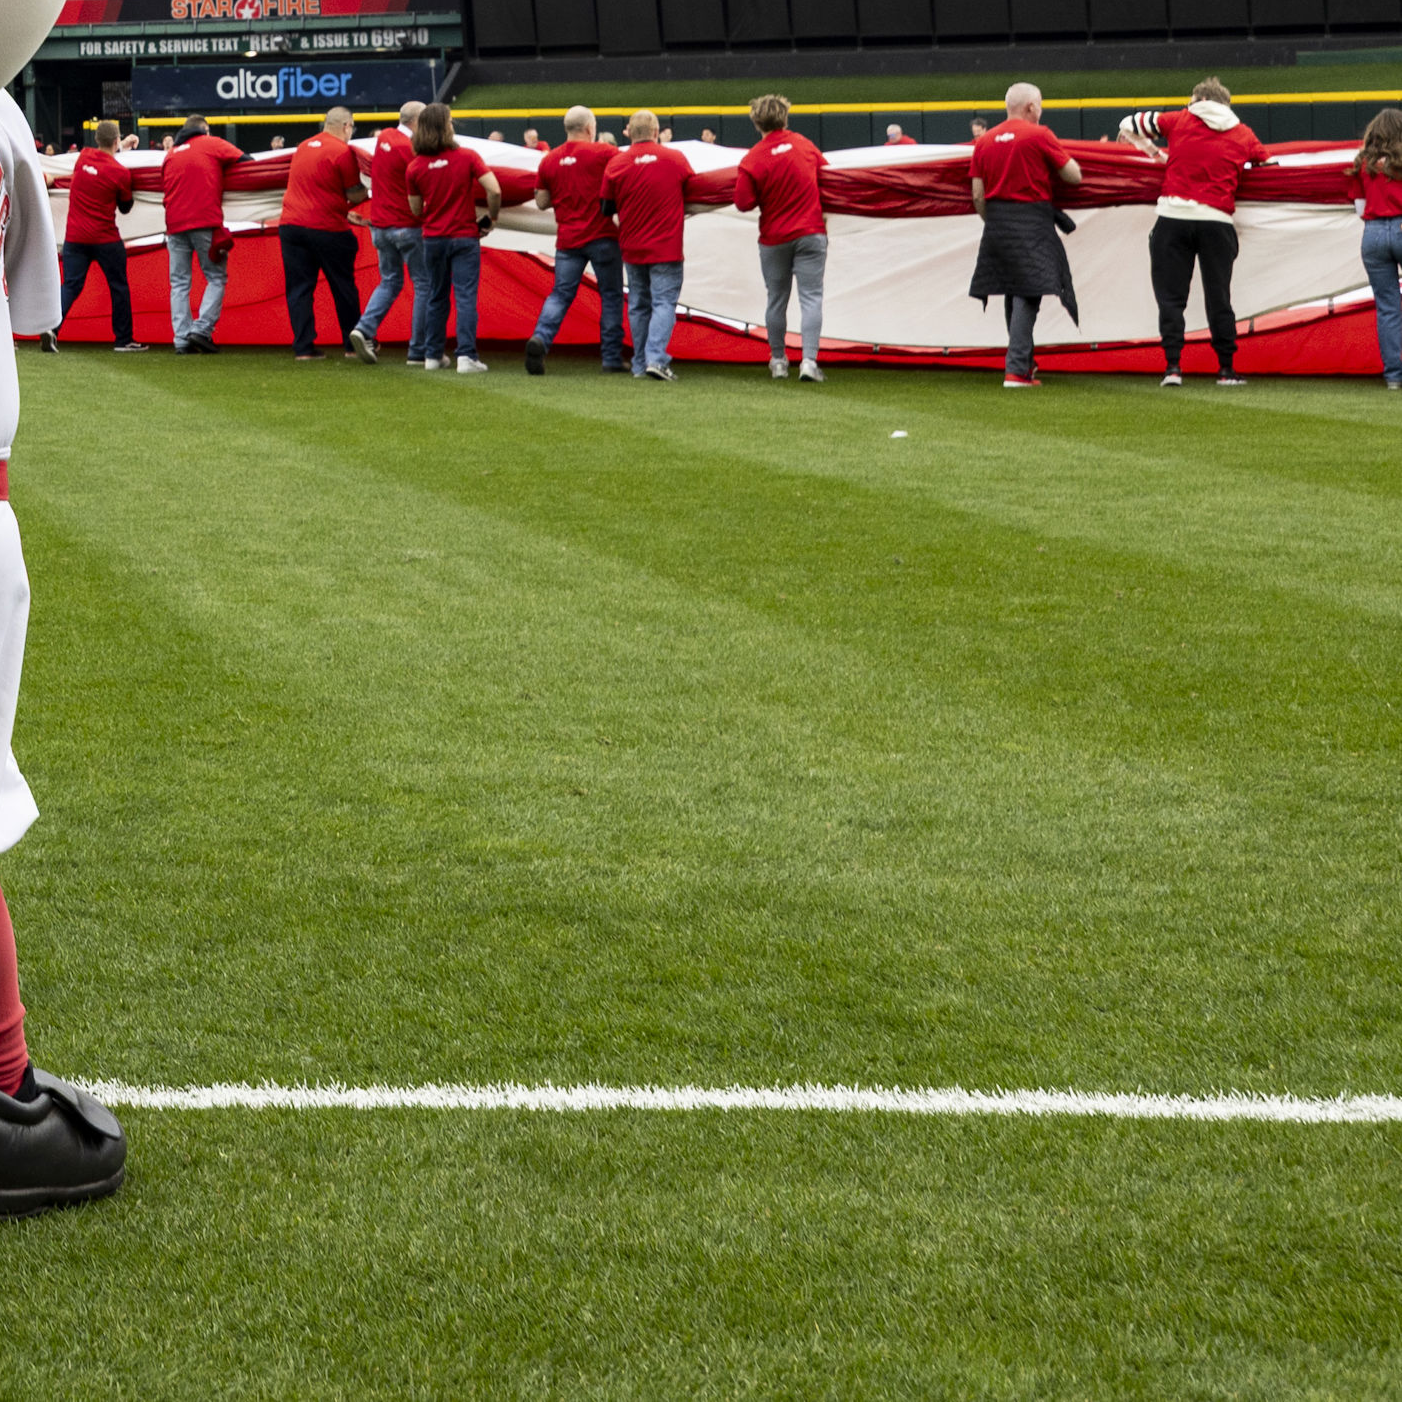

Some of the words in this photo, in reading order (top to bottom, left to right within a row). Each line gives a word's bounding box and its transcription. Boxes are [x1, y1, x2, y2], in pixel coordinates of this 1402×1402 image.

[80, 41, 101, 56] FOR
[104, 40, 146, 55] SAFETY
[148, 41, 156, 53] &
[159, 38, 209, 54] SERVICE
[211, 37, 238, 51] TEXT
[300, 36, 309, 48] &
[312, 33, 349, 48] ISSUE
[351, 32, 368, 46] TO
[216, 67, 352, 104] altafiber
